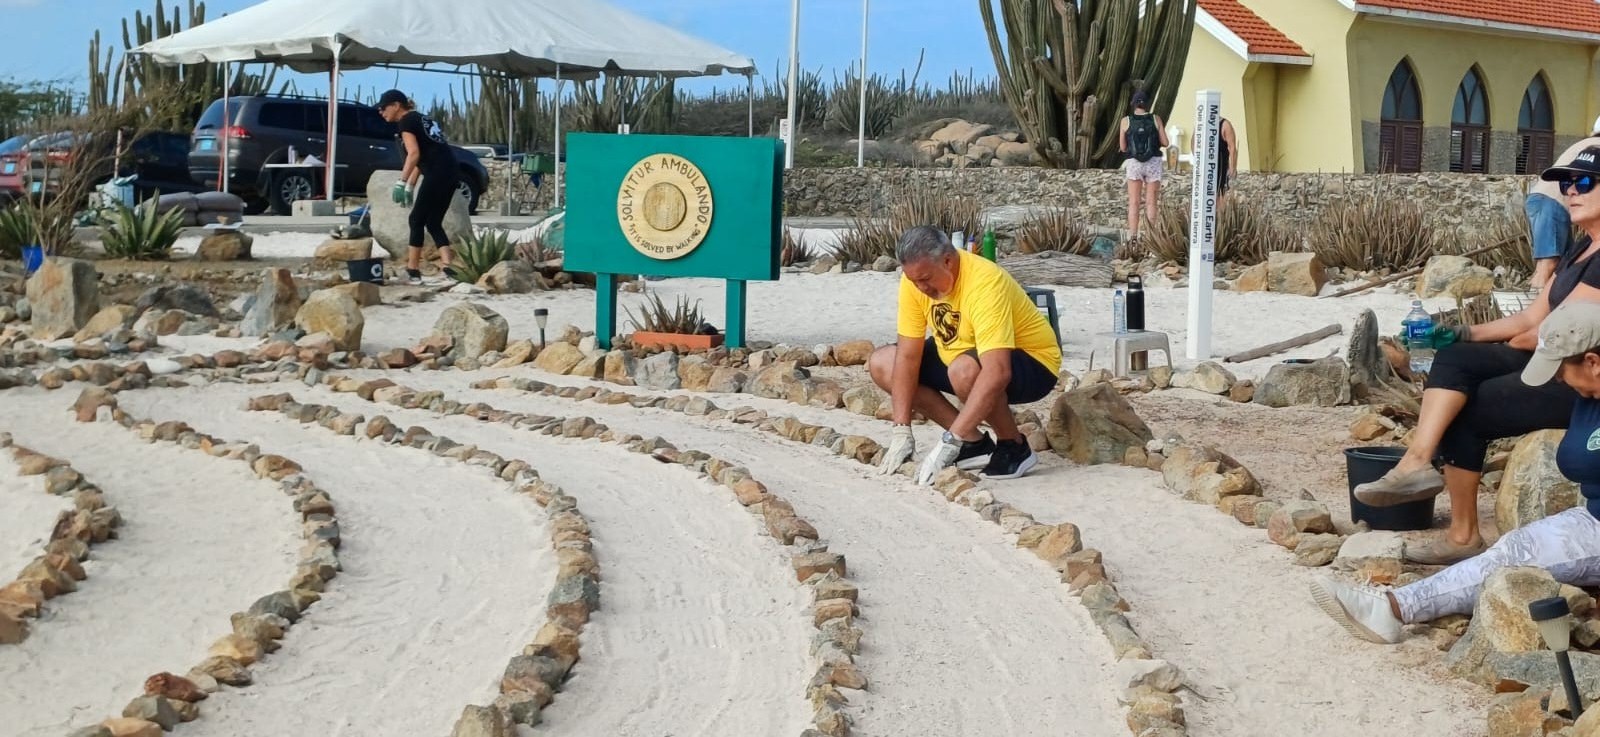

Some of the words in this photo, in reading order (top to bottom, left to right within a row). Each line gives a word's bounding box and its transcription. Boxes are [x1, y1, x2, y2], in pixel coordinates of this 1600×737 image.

[1208, 104, 1218, 126] May
[1208, 128, 1218, 160] Peace
[1194, 151, 1203, 197] prevalezca
[1206, 162, 1216, 196] Prevail
[622, 161, 654, 222] SOLVITUR
[661, 157, 710, 224] AMBULANDO
[1194, 199, 1201, 209] en
[1205, 198, 1215, 212] On
[641, 240, 664, 253] SOLVED
[675, 229, 701, 250] WALKING
[1192, 221, 1200, 244] tierra
[1204, 216, 1214, 243] Earth
